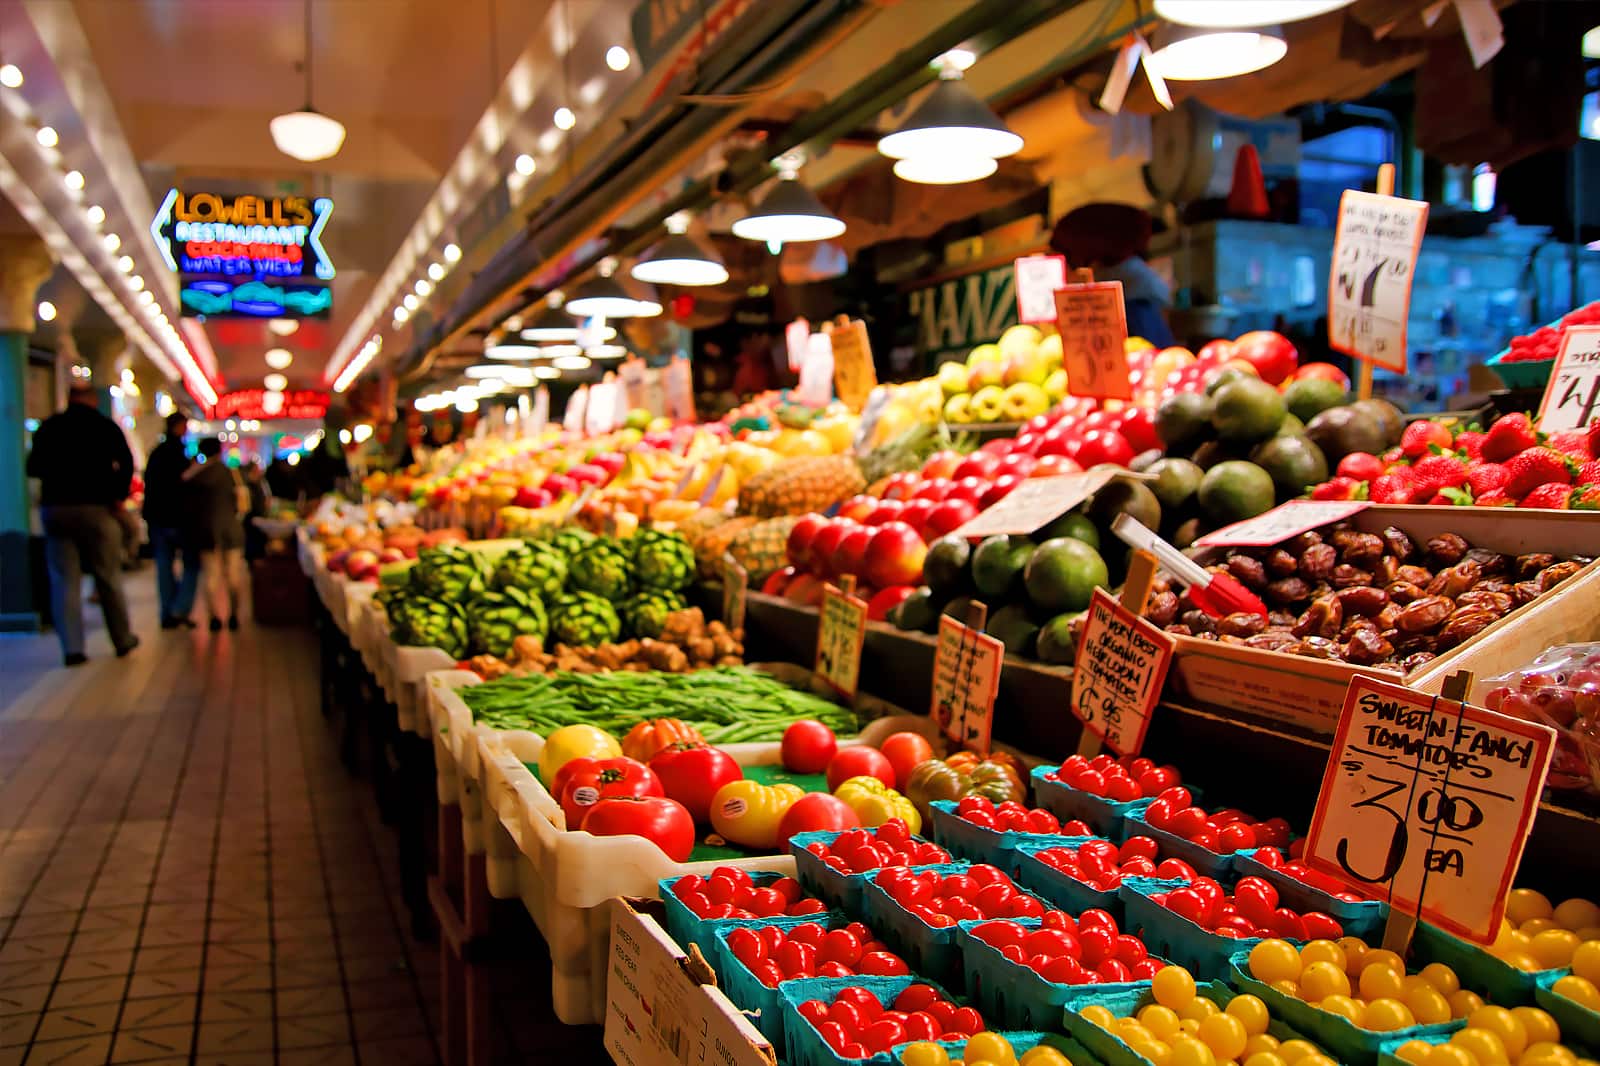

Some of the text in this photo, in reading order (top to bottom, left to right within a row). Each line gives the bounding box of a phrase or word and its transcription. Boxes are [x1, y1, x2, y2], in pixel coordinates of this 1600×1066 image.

[175, 191, 313, 226] LOWELL'S
[176, 221, 309, 246] RESTAURANT
[1094, 605, 1159, 657] THE VERY BEST
[1101, 632, 1146, 668] ORGANIC
[1364, 725, 1492, 779] TOMATOES
[1424, 848, 1464, 878] EA
